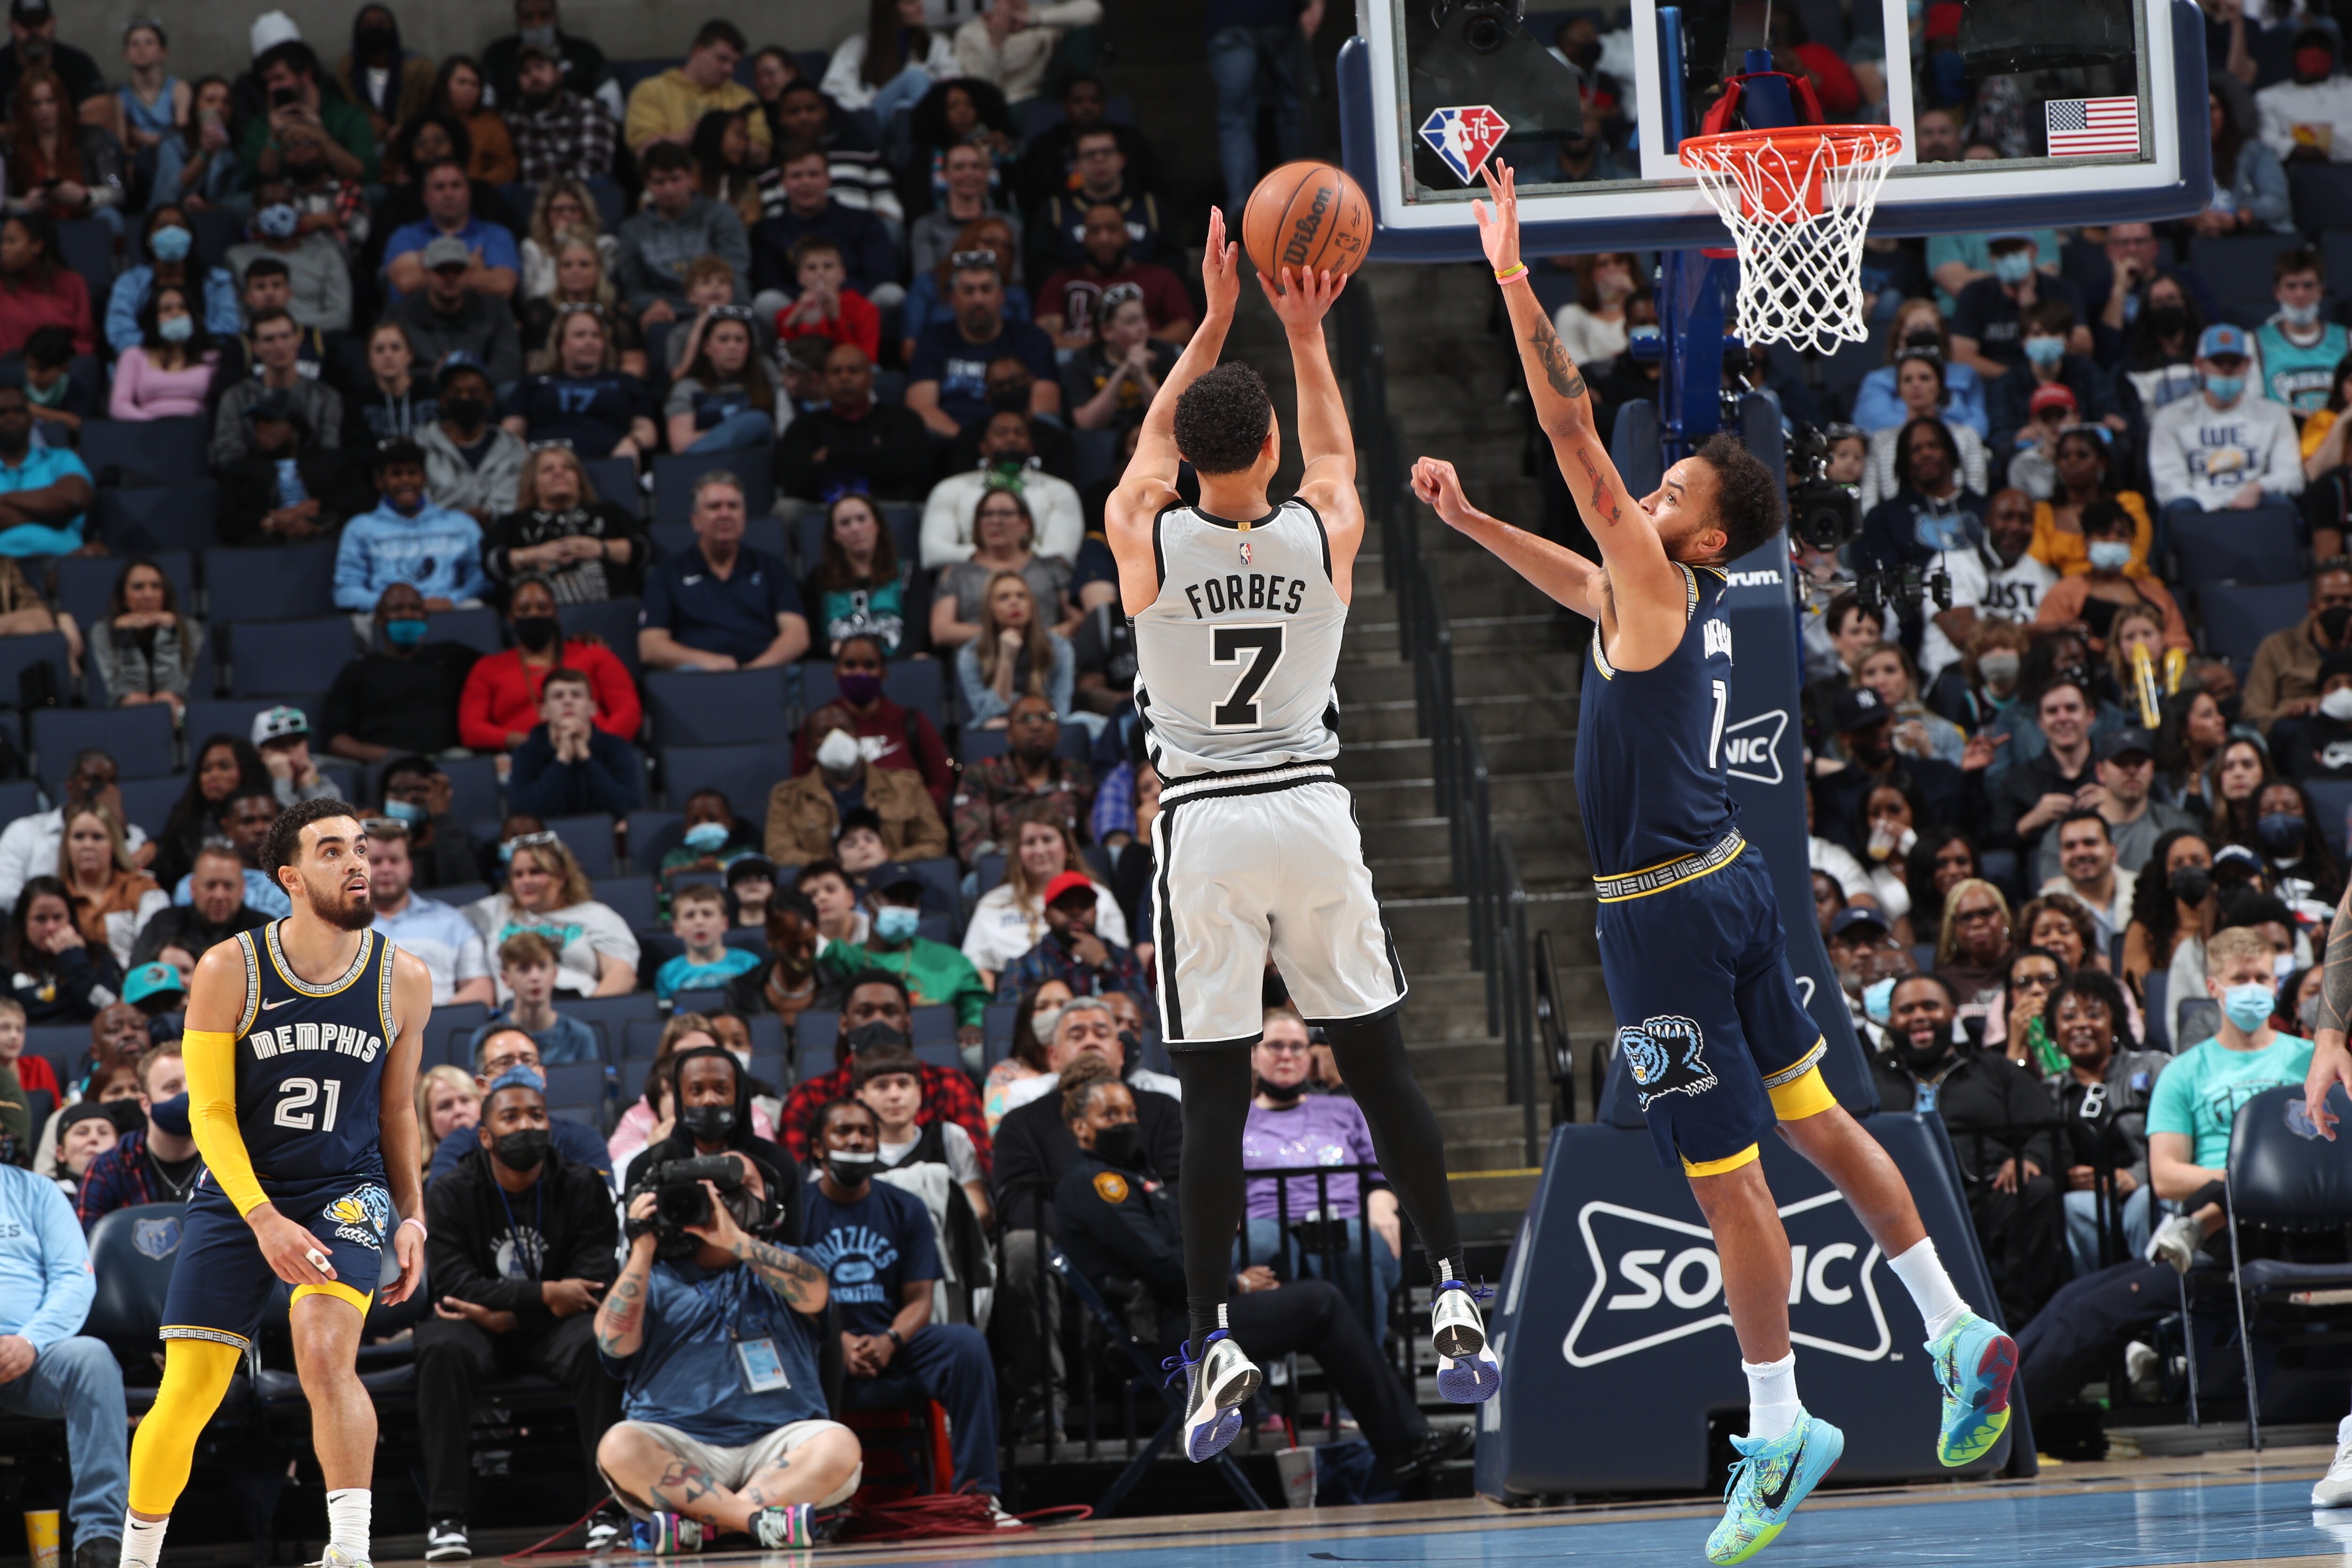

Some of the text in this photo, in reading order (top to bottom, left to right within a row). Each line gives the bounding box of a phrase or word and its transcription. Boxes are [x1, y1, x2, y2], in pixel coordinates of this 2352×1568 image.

[1471, 117, 1489, 140] 75
[1283, 187, 1334, 266] Wilson
[1185, 573, 1306, 620] FORBES
[1980, 580, 2036, 608] JUST
[1209, 621, 1287, 730] 7
[1709, 679, 1727, 769] 1
[249, 1023, 381, 1063] MEMPHIS
[274, 1077, 341, 1132] 21
[1607, 1242, 1858, 1310] SOIC
